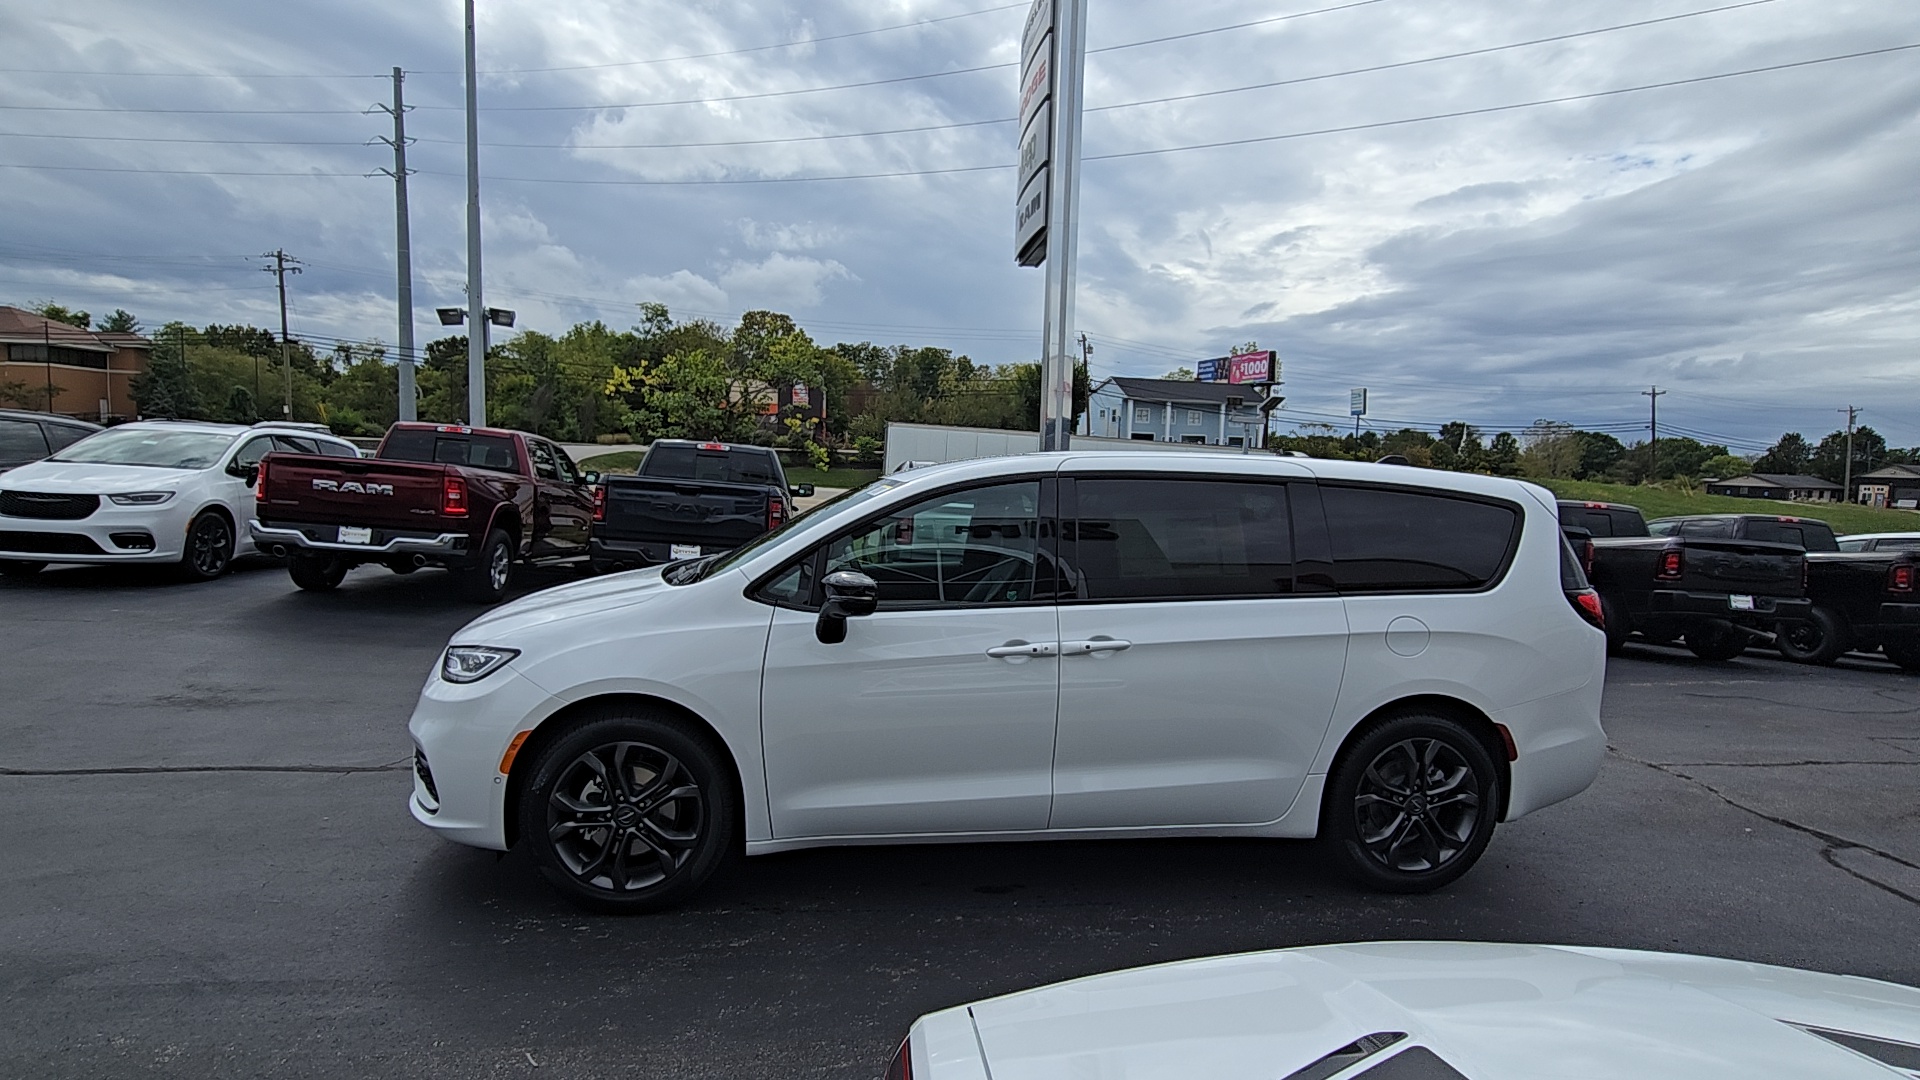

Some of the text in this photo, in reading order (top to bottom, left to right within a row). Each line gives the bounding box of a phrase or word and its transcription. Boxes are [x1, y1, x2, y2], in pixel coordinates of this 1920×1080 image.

[1019, 190, 1041, 232] RAM
[1240, 360, 1267, 375] $1000
[312, 478, 394, 496] RAM
[651, 501, 724, 516] RAM
